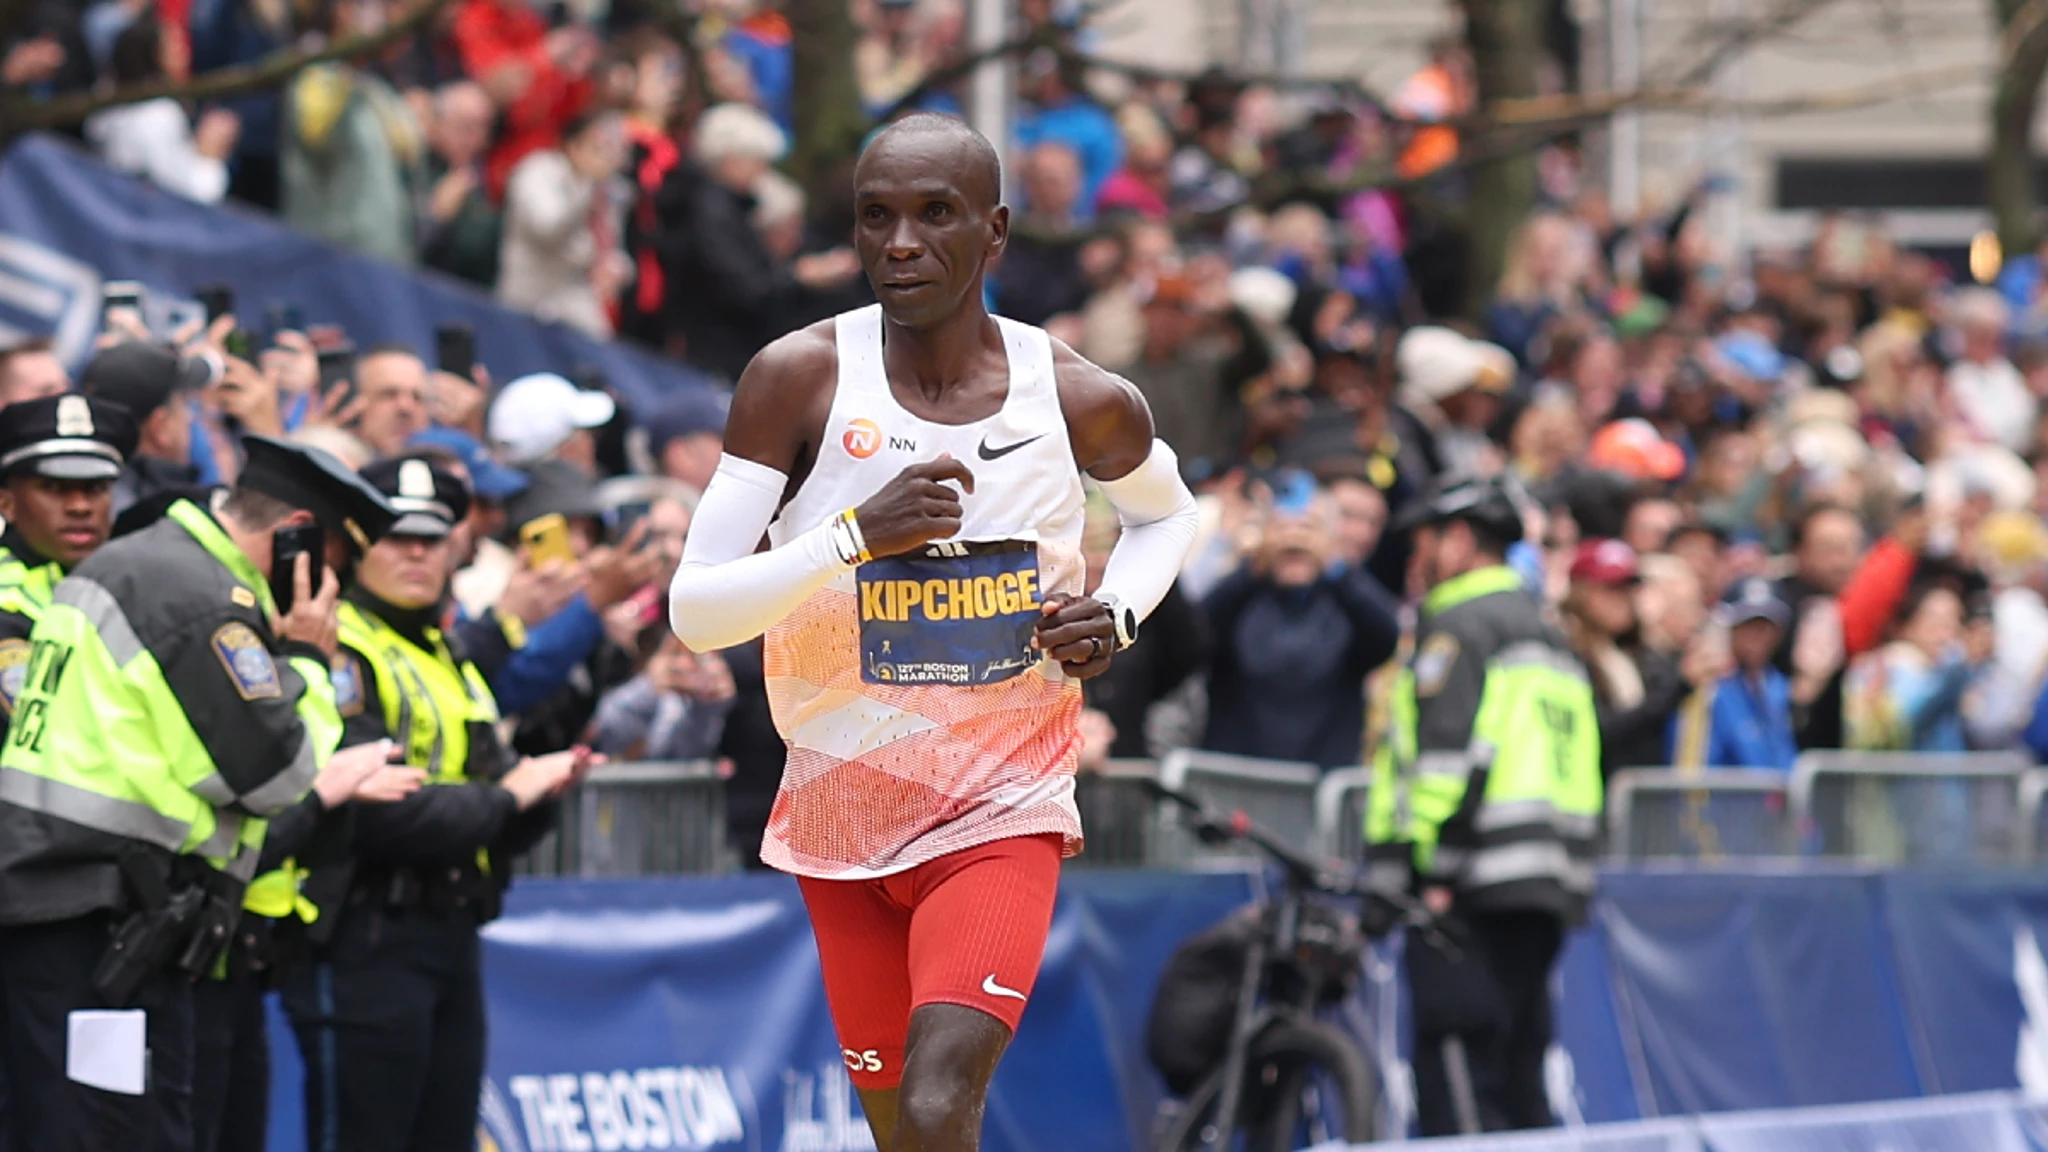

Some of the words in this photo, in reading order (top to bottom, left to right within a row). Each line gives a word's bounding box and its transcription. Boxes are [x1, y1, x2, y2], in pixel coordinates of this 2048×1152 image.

[889, 436, 916, 452] NN
[860, 569, 1041, 622] KIPCHOGE
[899, 671, 969, 682] MARATHON
[923, 662, 969, 674] BOSTON
[841, 1048, 883, 1072] OS
[510, 1073, 591, 1151] THE
[581, 1066, 744, 1151] BOSTON
